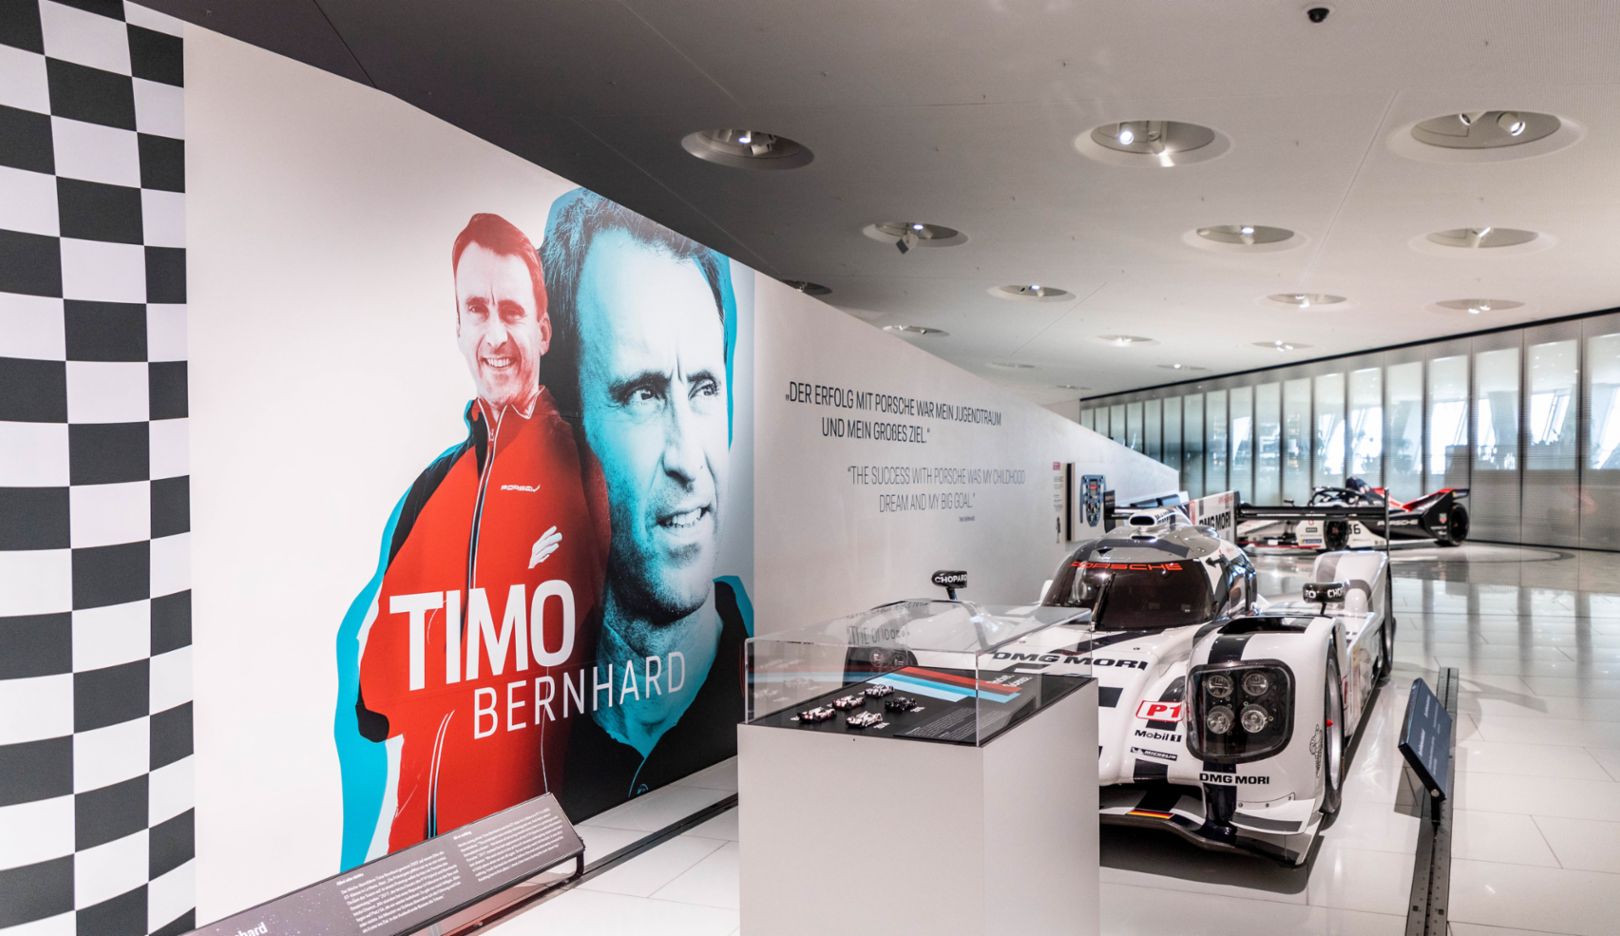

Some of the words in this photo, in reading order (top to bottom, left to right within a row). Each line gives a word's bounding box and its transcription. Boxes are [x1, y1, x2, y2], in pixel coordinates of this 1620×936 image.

[815, 385, 854, 409] ERFOLG
[856, 391, 873, 411] MIT
[875, 394, 915, 416] PORSCHE
[916, 400, 935, 418] WAR
[935, 403, 954, 420] MEIN
[954, 405, 1002, 427] JUGENDTRAUM
[822, 417, 845, 438] UND
[847, 419, 871, 440] MEIN
[871, 466, 911, 485] SUCCESS
[912, 467, 932, 485] WITH
[934, 467, 967, 485] PORSCHE
[967, 468, 982, 485] WAS
[982, 469, 992, 484] MY
[993, 469, 1026, 485] CHILDHOOD
[879, 494, 909, 513] DREAM
[910, 495, 926, 512] AND
[928, 495, 939, 511] MY
[940, 494, 953, 510] BIG
[1215, 511, 1231, 530] MORI
[1070, 560, 1184, 571] PORSCHE
[389, 579, 577, 692] TIMO
[992, 650, 1059, 664] DMG
[1063, 656, 1148, 670] MORI
[473, 650, 686, 740] BERNHARD
[1146, 702, 1182, 719] P1
[1134, 729, 1169, 742] Mobil
[1200, 773, 1233, 784] DMG
[1235, 774, 1270, 785] MORI
